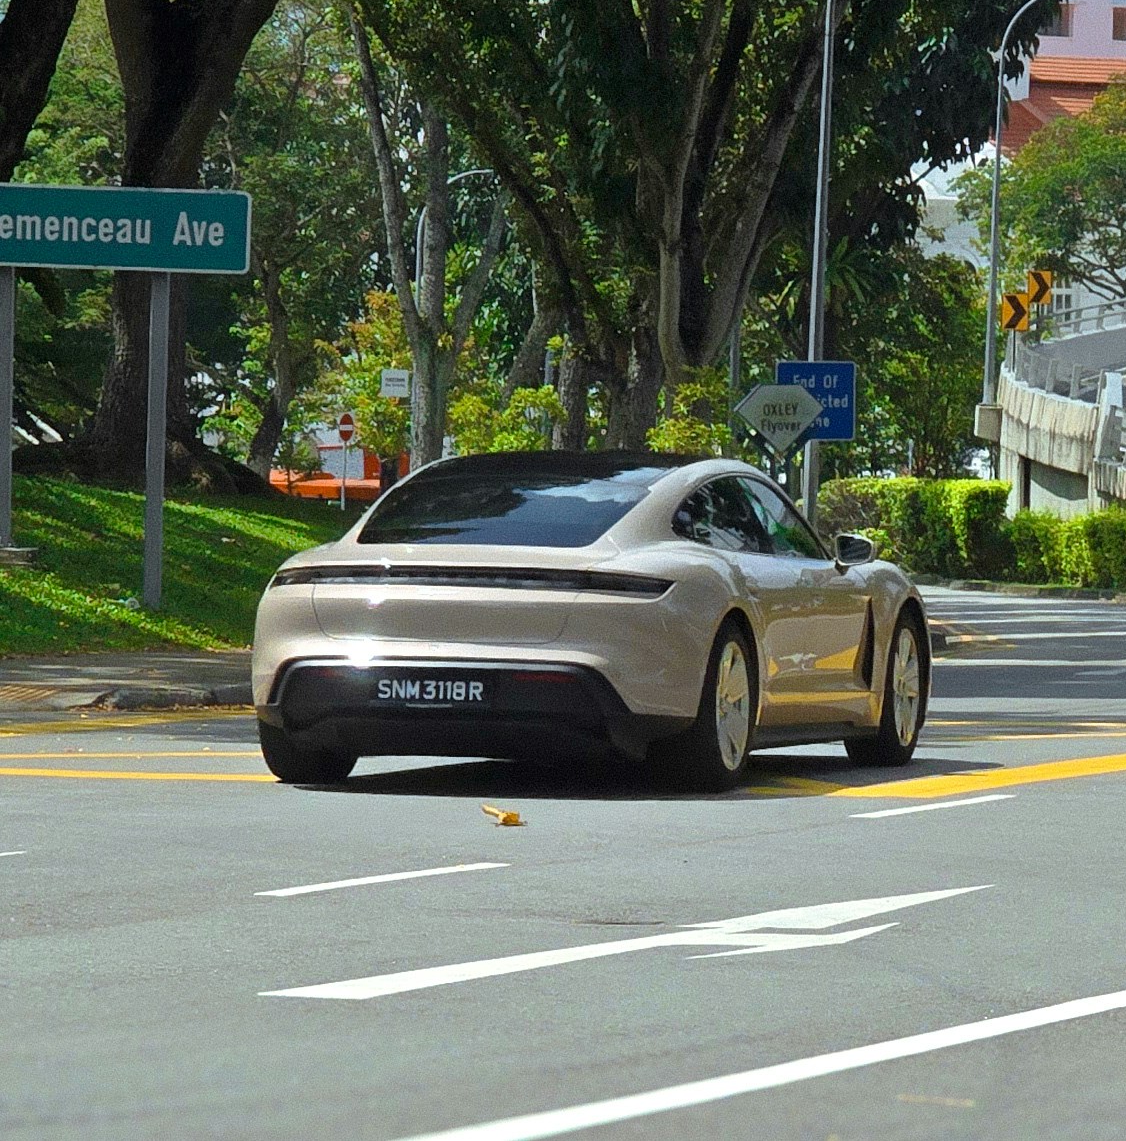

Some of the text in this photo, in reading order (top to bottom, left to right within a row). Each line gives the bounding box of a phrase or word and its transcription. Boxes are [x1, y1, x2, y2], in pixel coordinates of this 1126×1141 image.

[172, 211, 225, 247] Ave
[823, 374, 839, 389] Of
[762, 403, 799, 417] OXLEY
[760, 418, 802, 435] Flyover
